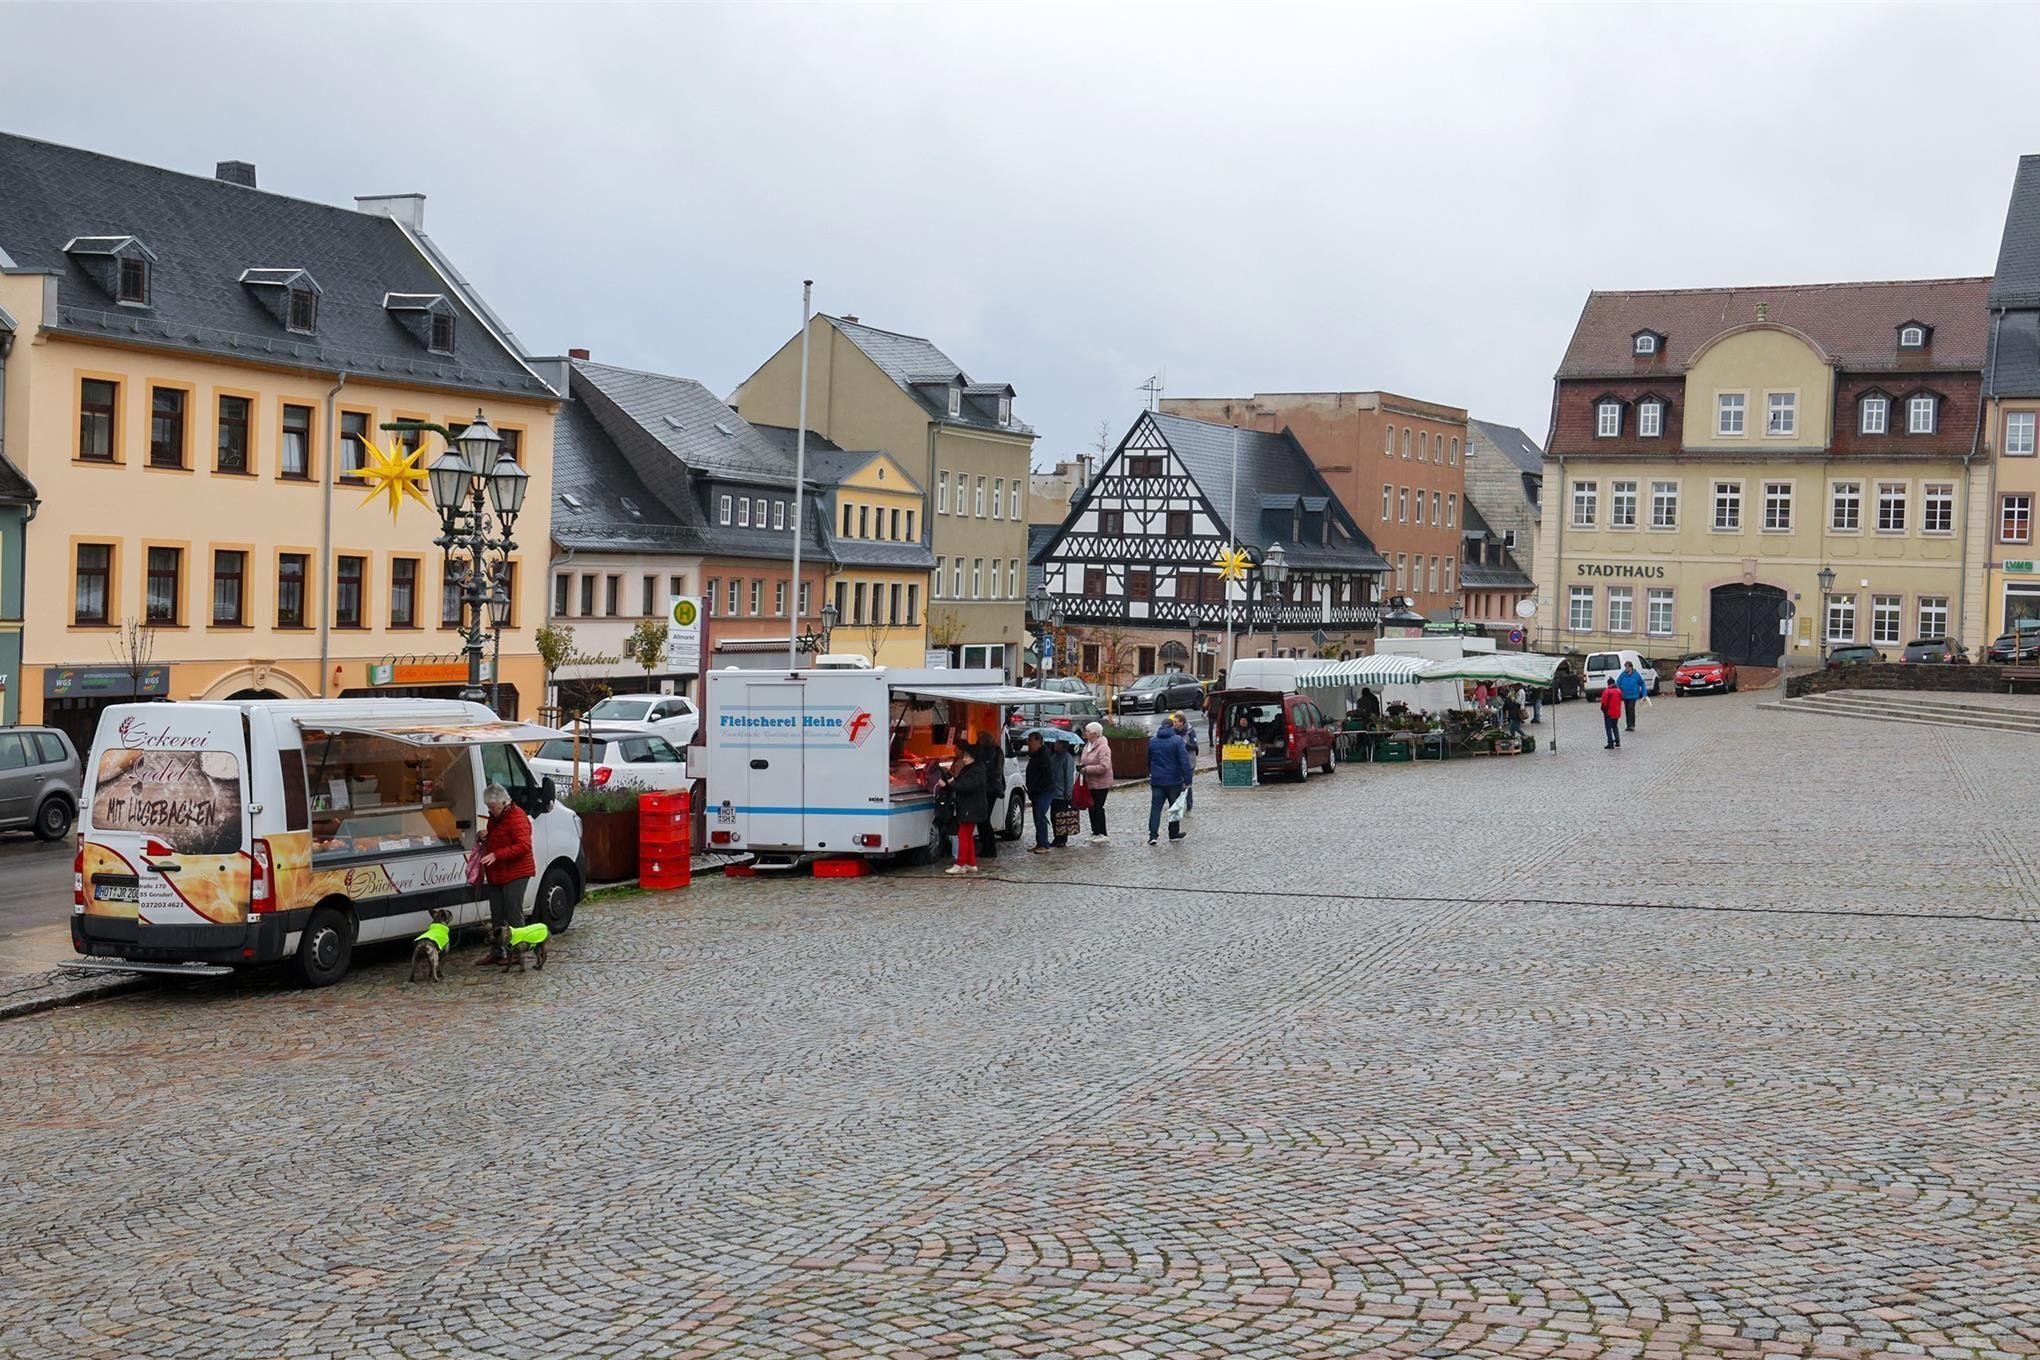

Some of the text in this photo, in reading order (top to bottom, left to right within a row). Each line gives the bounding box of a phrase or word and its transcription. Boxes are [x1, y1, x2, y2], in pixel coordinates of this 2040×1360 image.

[1577, 564, 1664, 578] STADTHAUS
[680, 605, 691, 620] H
[1045, 638, 1051, 655] P
[720, 715, 843, 727] Fleischerei Heine
[107, 797, 125, 823] MIT
[420, 862, 466, 887] Riedel
[100, 886, 114, 897] HOT
[117, 888, 127, 898] JR
